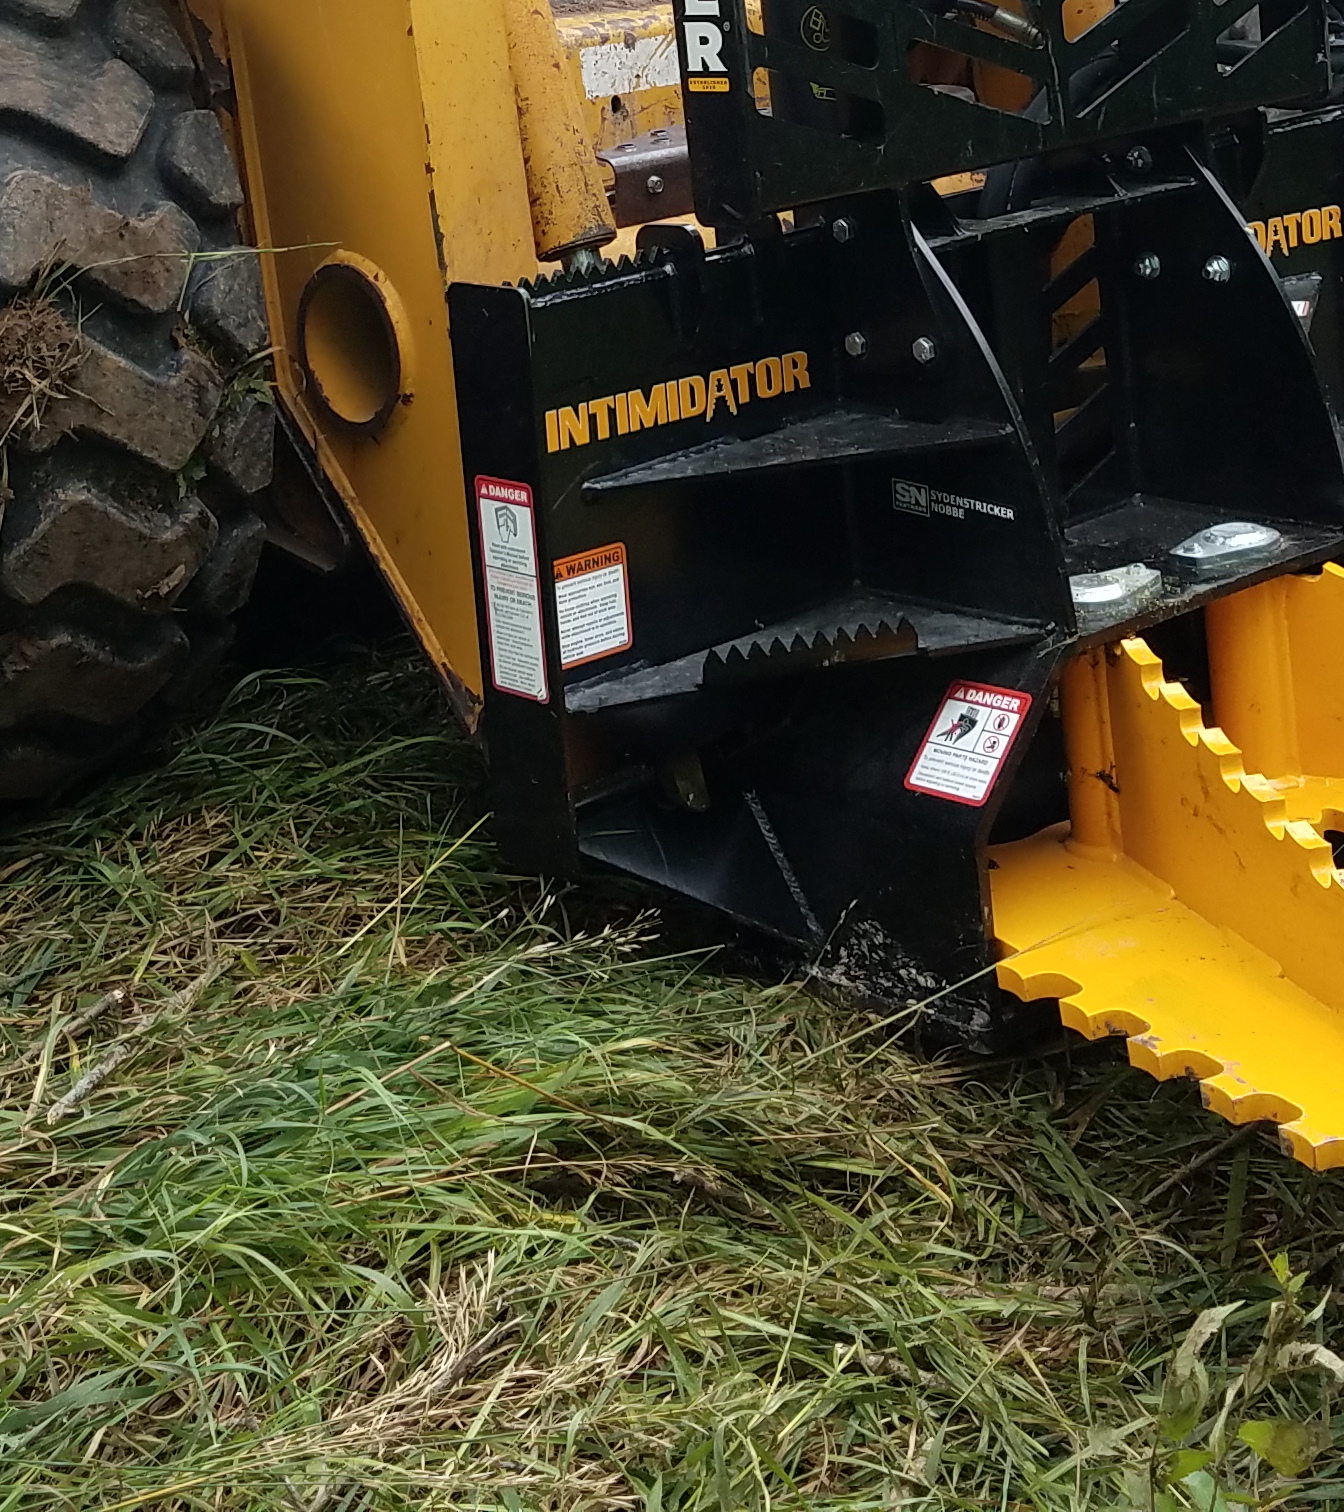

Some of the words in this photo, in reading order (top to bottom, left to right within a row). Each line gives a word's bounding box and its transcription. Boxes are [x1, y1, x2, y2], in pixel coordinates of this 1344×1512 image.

[545, 350, 811, 454] INTIMIDATOR
[488, 484, 528, 503] DANGER
[896, 483, 926, 506] SN
[930, 490, 1015, 520] SYDENSTRICKER
[931, 501, 965, 519] NOBBE
[566, 551, 619, 576] WARNING
[965, 689, 1021, 711] DANGER
